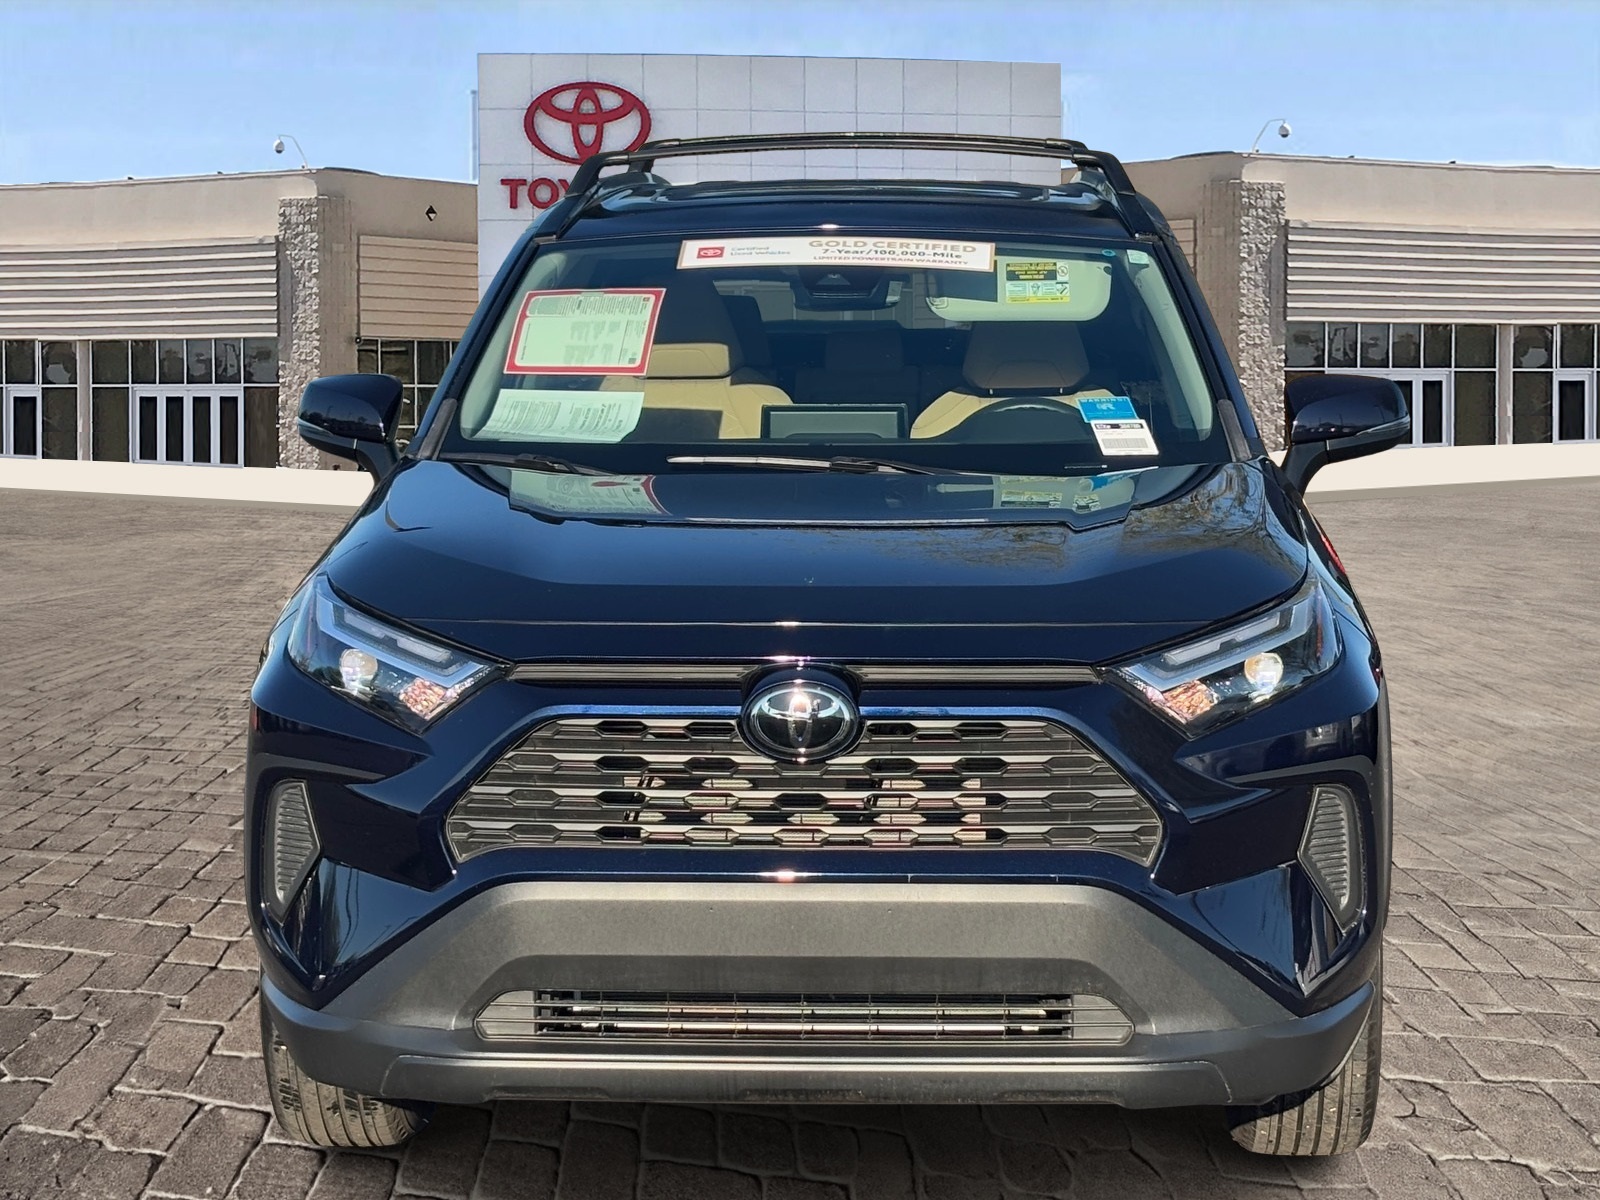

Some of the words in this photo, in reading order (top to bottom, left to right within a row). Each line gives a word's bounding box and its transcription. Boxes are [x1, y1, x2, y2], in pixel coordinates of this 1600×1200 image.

[808, 239, 868, 248] GOLD
[872, 240, 977, 253] CERTIFIED
[821, 248, 962, 259] 7-Year/100,000-Mile
[915, 257, 969, 265] WARRANTY
